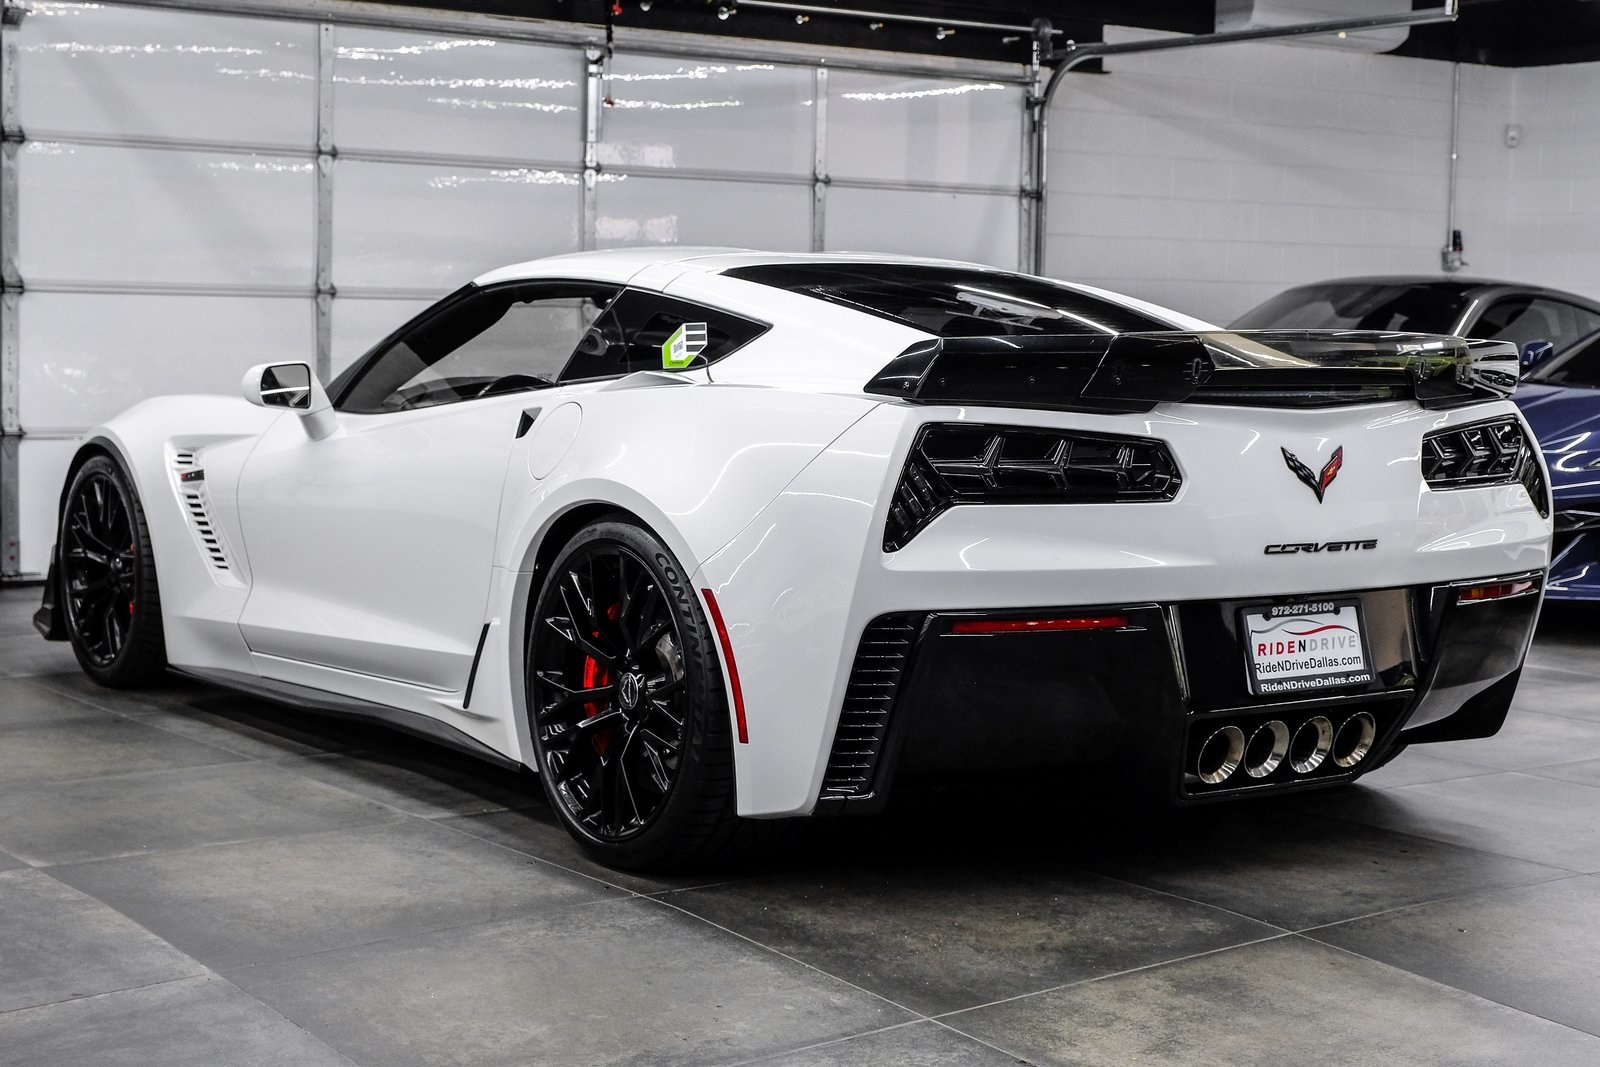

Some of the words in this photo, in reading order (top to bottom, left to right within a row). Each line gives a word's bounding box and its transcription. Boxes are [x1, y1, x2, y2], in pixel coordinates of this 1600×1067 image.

[1264, 539, 1378, 555] CORVETTE
[1271, 602, 1335, 616] 972-271-5100
[1255, 655, 1362, 674] RideNDriveDallas.com
[1260, 673, 1371, 692] RideNDriveDallas.com
